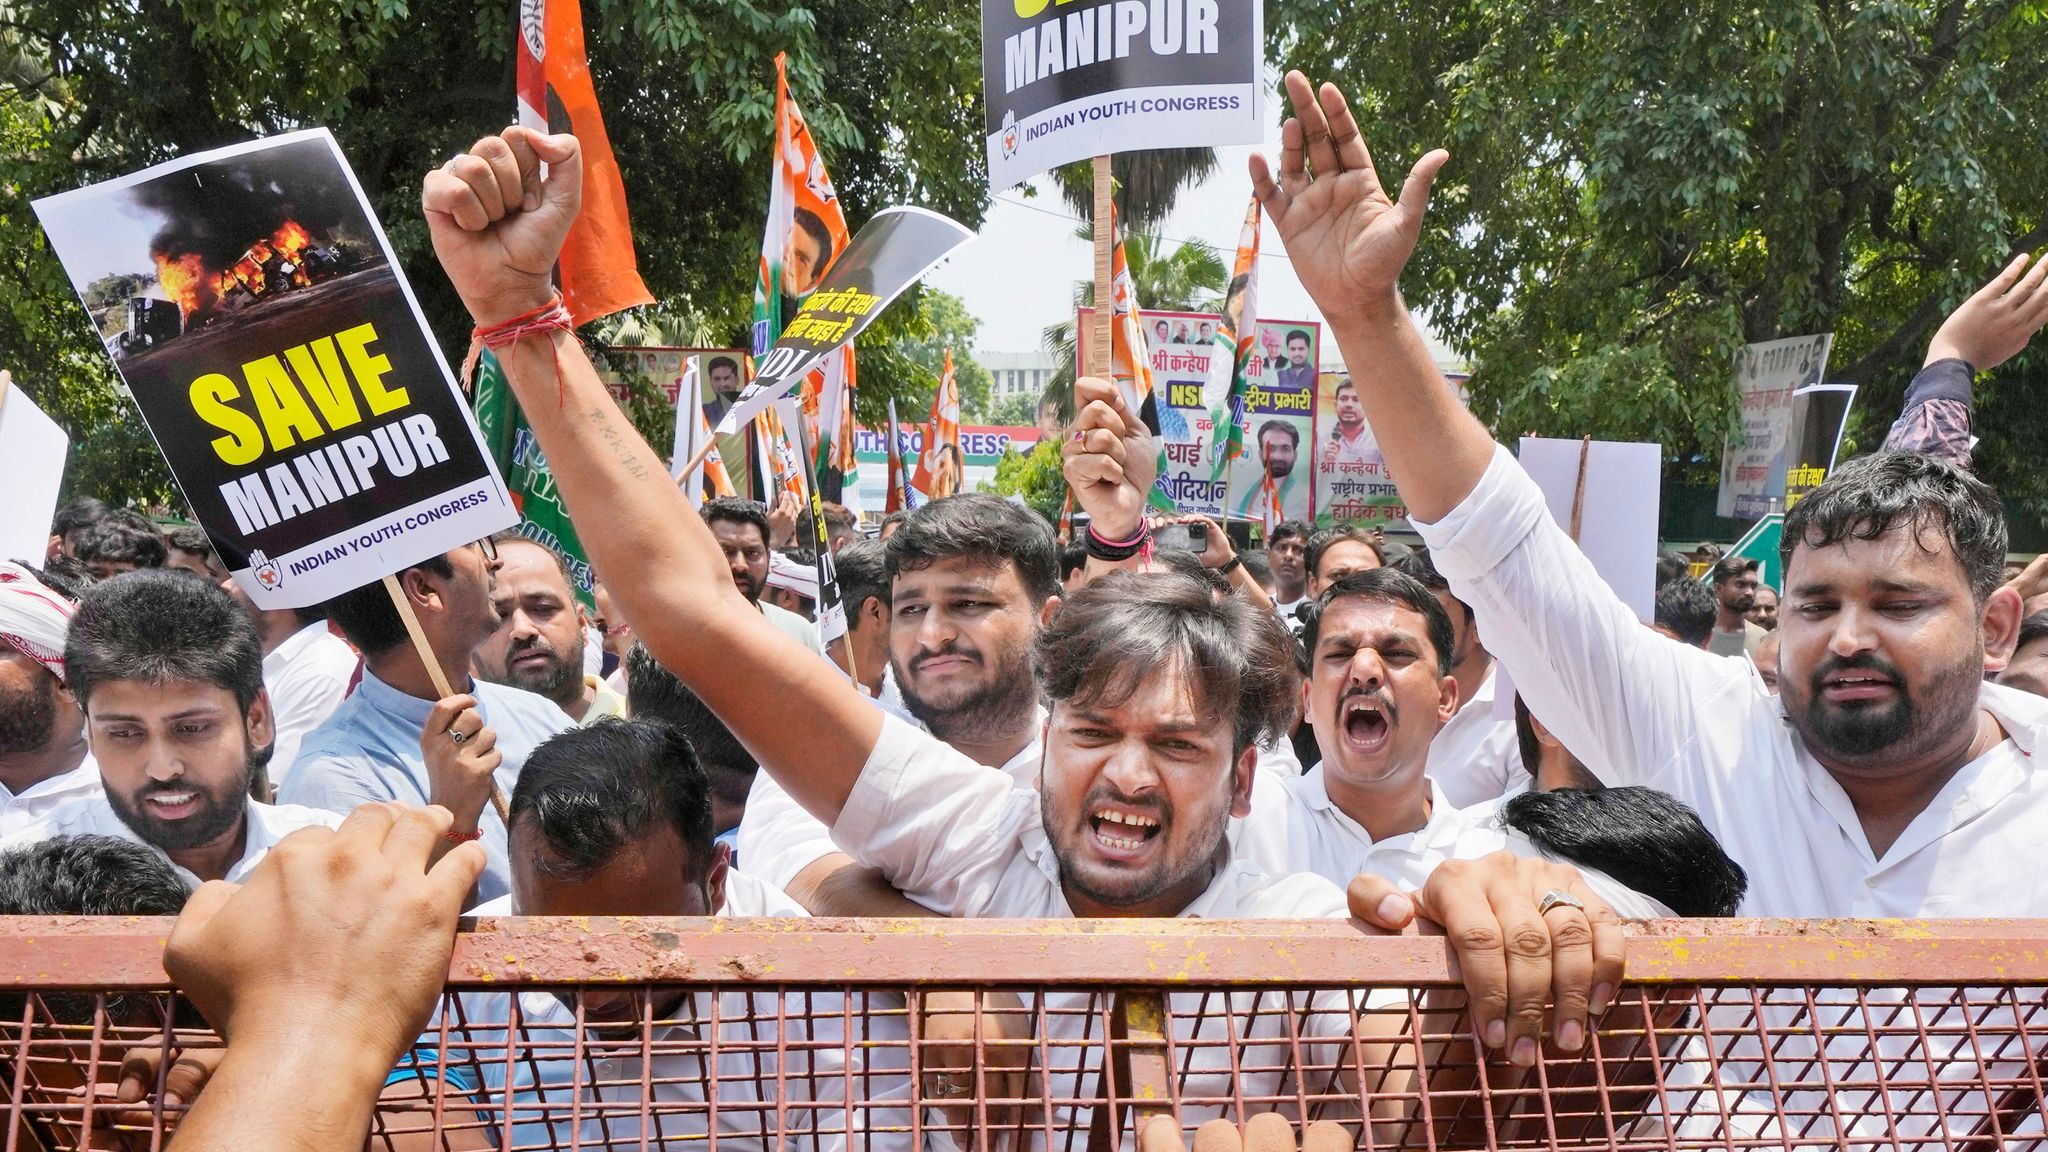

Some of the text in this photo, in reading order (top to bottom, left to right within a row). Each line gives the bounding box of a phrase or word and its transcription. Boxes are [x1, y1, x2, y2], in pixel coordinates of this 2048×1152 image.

[1005, 0, 1219, 94] MANIPUR
[1026, 95, 1240, 142] INDIAN YOUTH CONGRESS
[828, 287, 858, 313] की
[845, 292, 883, 316] रक्षा
[830, 316, 855, 344] है
[1152, 349, 1168, 372] श्री
[1247, 355, 1264, 377] जी
[189, 322, 411, 466] SAVE
[899, 433, 1010, 455] CORESS
[218, 413, 450, 537] MANIPUR
[1367, 484, 1397, 496] प्रभार
[1330, 497, 1379, 522] हार्दिक
[289, 489, 489, 577] INDIAN YOUTH CONGRESS
